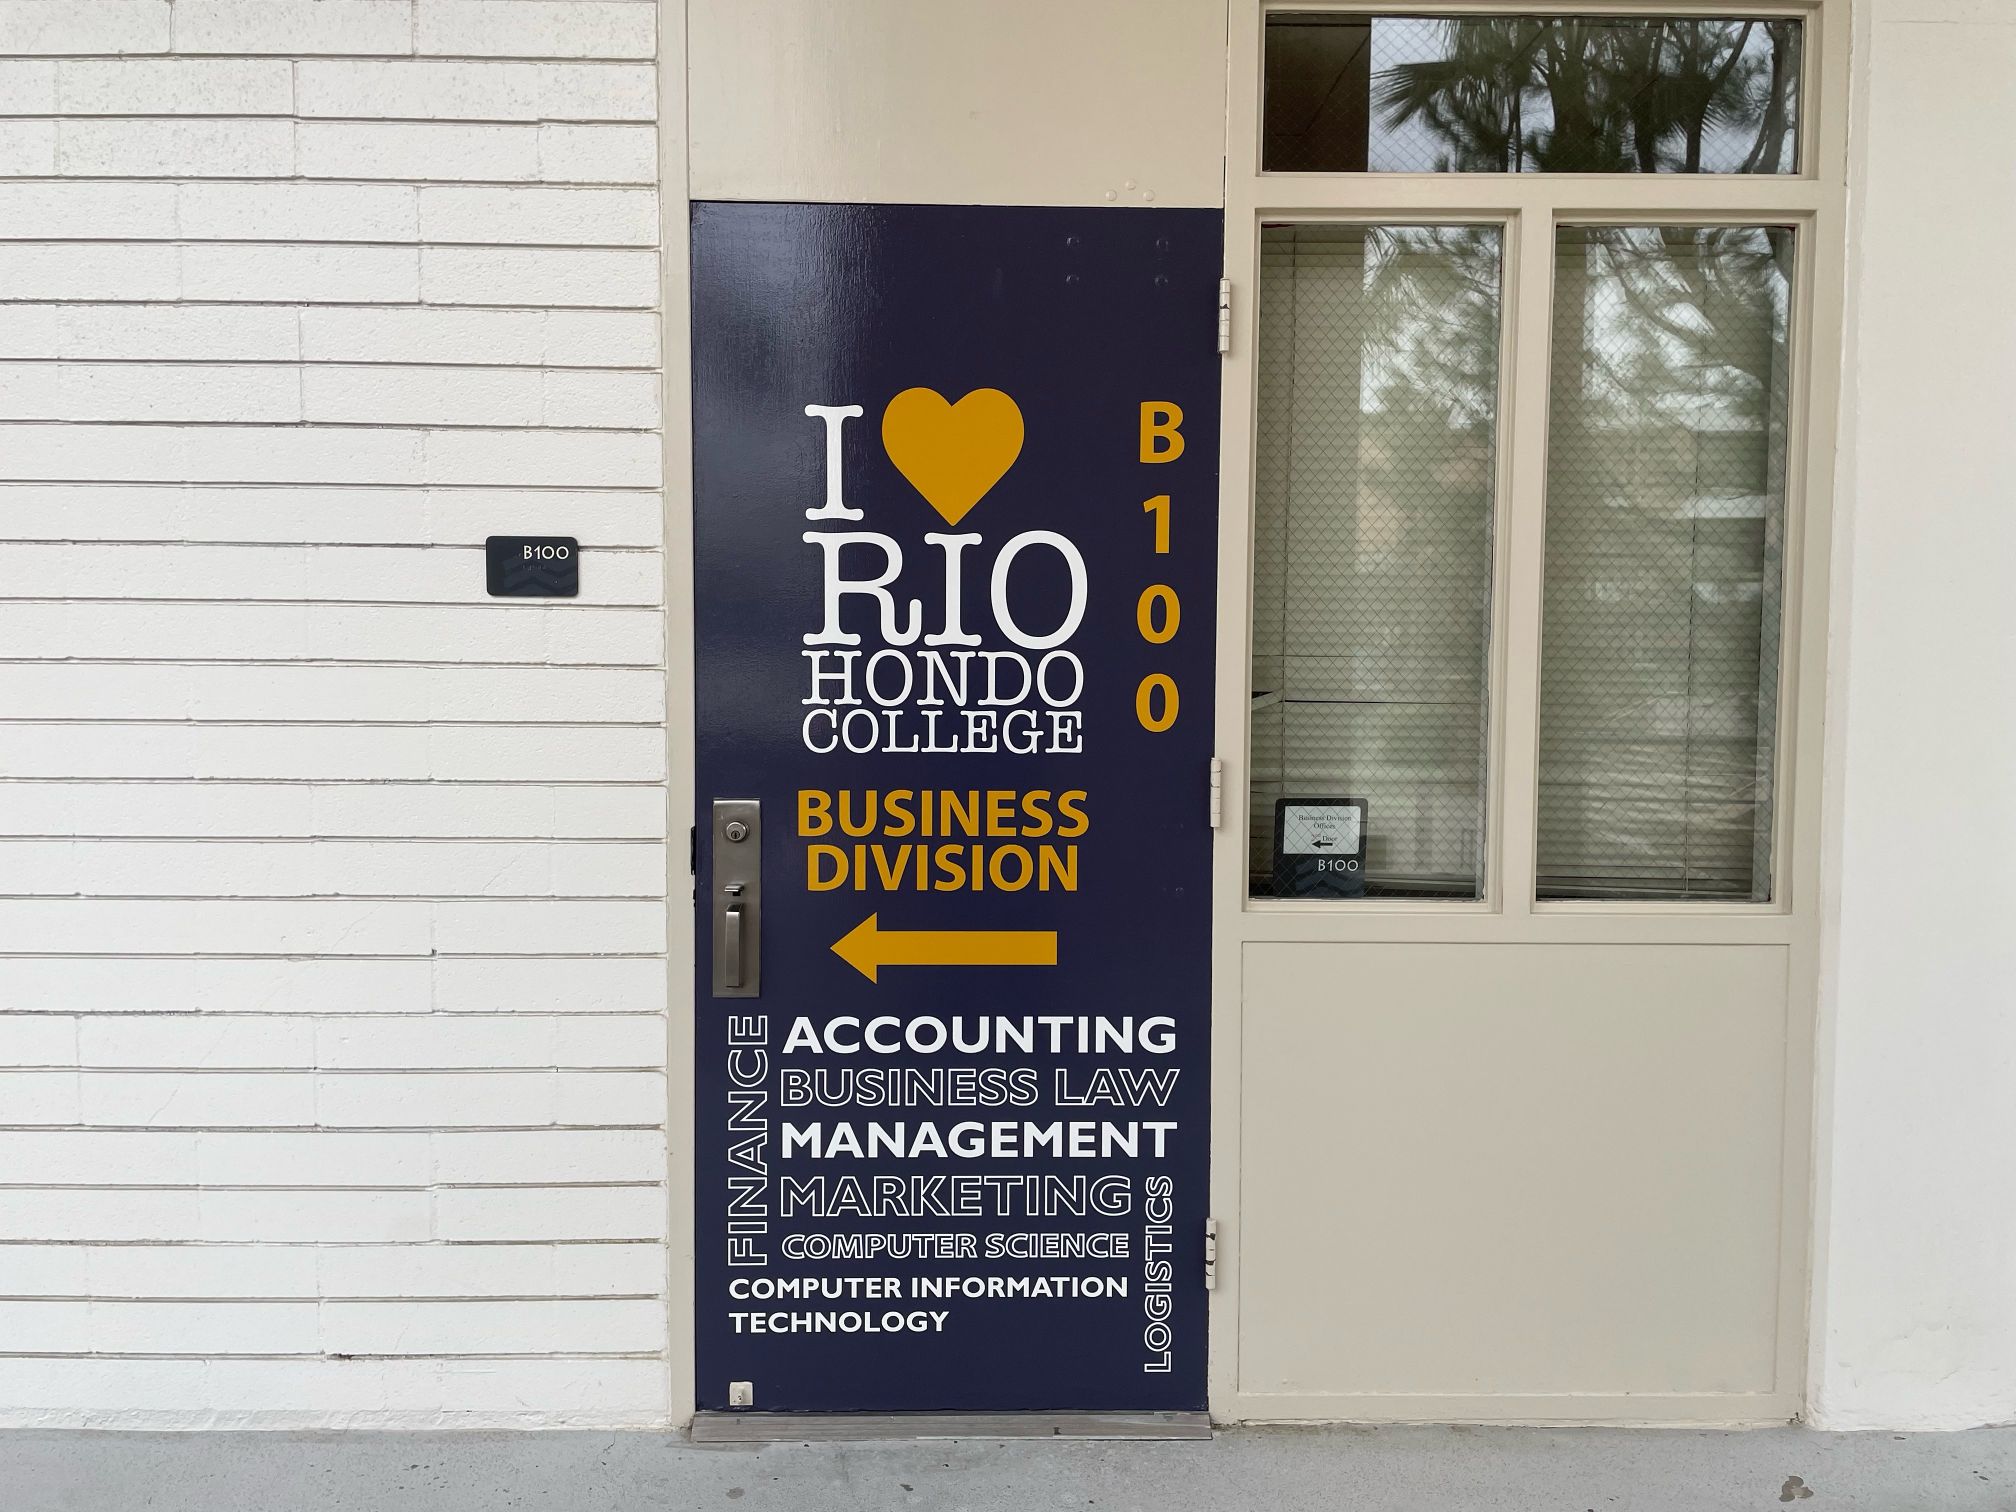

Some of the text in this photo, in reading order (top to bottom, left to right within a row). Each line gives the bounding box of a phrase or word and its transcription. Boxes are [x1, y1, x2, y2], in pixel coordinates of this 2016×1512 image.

[805, 404, 865, 520] I
[523, 545, 569, 559] B100
[803, 530, 1088, 649] RIO
[802, 649, 1084, 707] HONDO
[802, 709, 1082, 754] COLLEGE
[798, 789, 1089, 837] BUSINESS
[806, 844, 1078, 891] DIVISION
[1318, 859, 1359, 871] B100
[782, 1016, 1177, 1054] ACCOUNTING
[781, 1068, 1180, 1107] BUSINESS LAW
[728, 1015, 768, 1266] FINANCE
[781, 1122, 1178, 1158] MANAGEMENT
[781, 1175, 1132, 1217] MARKETING
[781, 1233, 1130, 1259] COMPUTER SCIENCE
[728, 1277, 1128, 1300] COMPUTER INFORMATION
[1144, 1175, 1173, 1373] LOGISTICS
[728, 1311, 949, 1334] TECHNOLOGY
